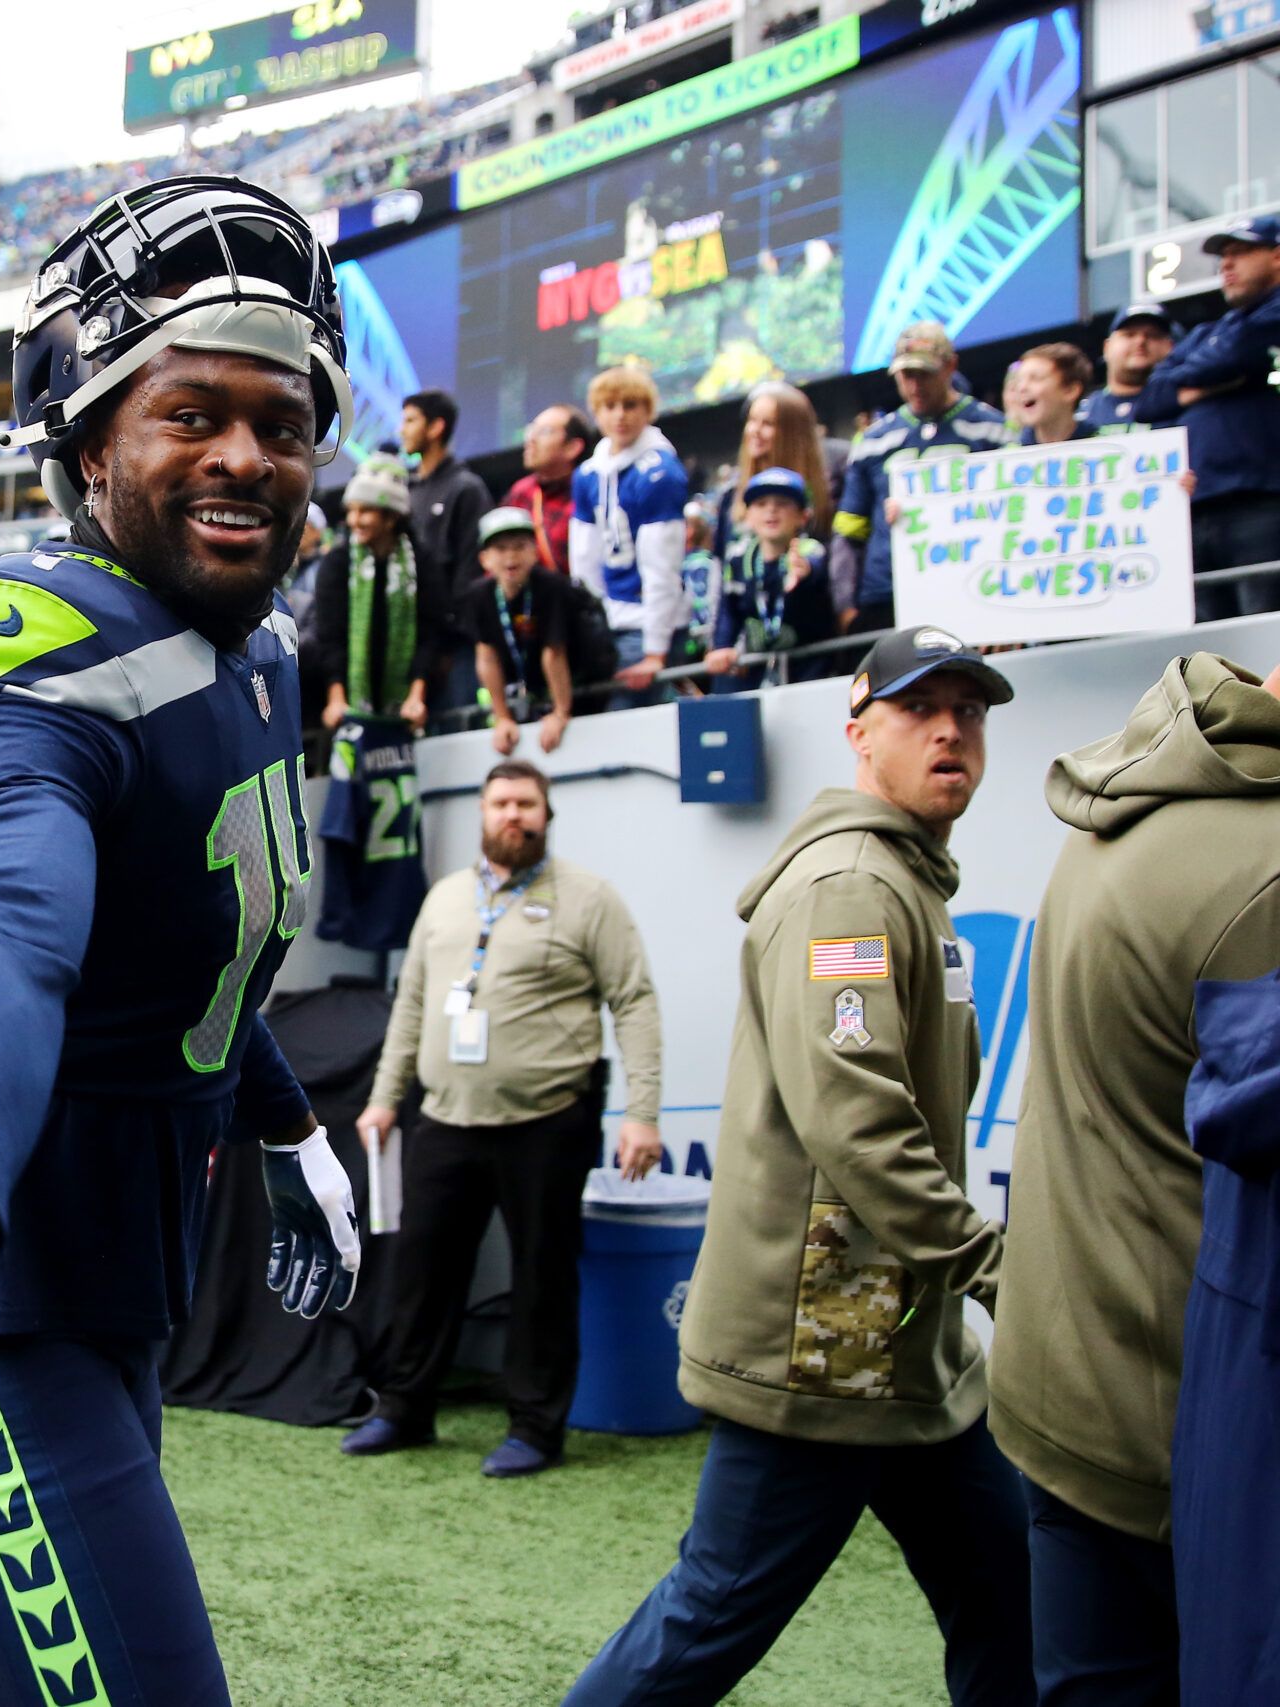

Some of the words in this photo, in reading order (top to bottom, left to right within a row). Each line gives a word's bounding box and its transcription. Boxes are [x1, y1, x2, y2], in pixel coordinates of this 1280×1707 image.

[473, 111, 653, 194] COUNTDOWN
[664, 89, 701, 123] TO
[715, 29, 845, 101] KICKOFF
[537, 262, 621, 332] NYG
[651, 231, 728, 300] SEA
[1148, 243, 1181, 294] 2
[996, 454, 1122, 490] LOCKETT
[1135, 450, 1180, 474] CAN
[902, 508, 928, 535] I
[952, 494, 1026, 524] HAVE
[1046, 491, 1104, 520] ONE
[1122, 484, 1161, 511] OF
[182, 753, 315, 1074] 14
[841, 1016, 861, 1028] NFL
